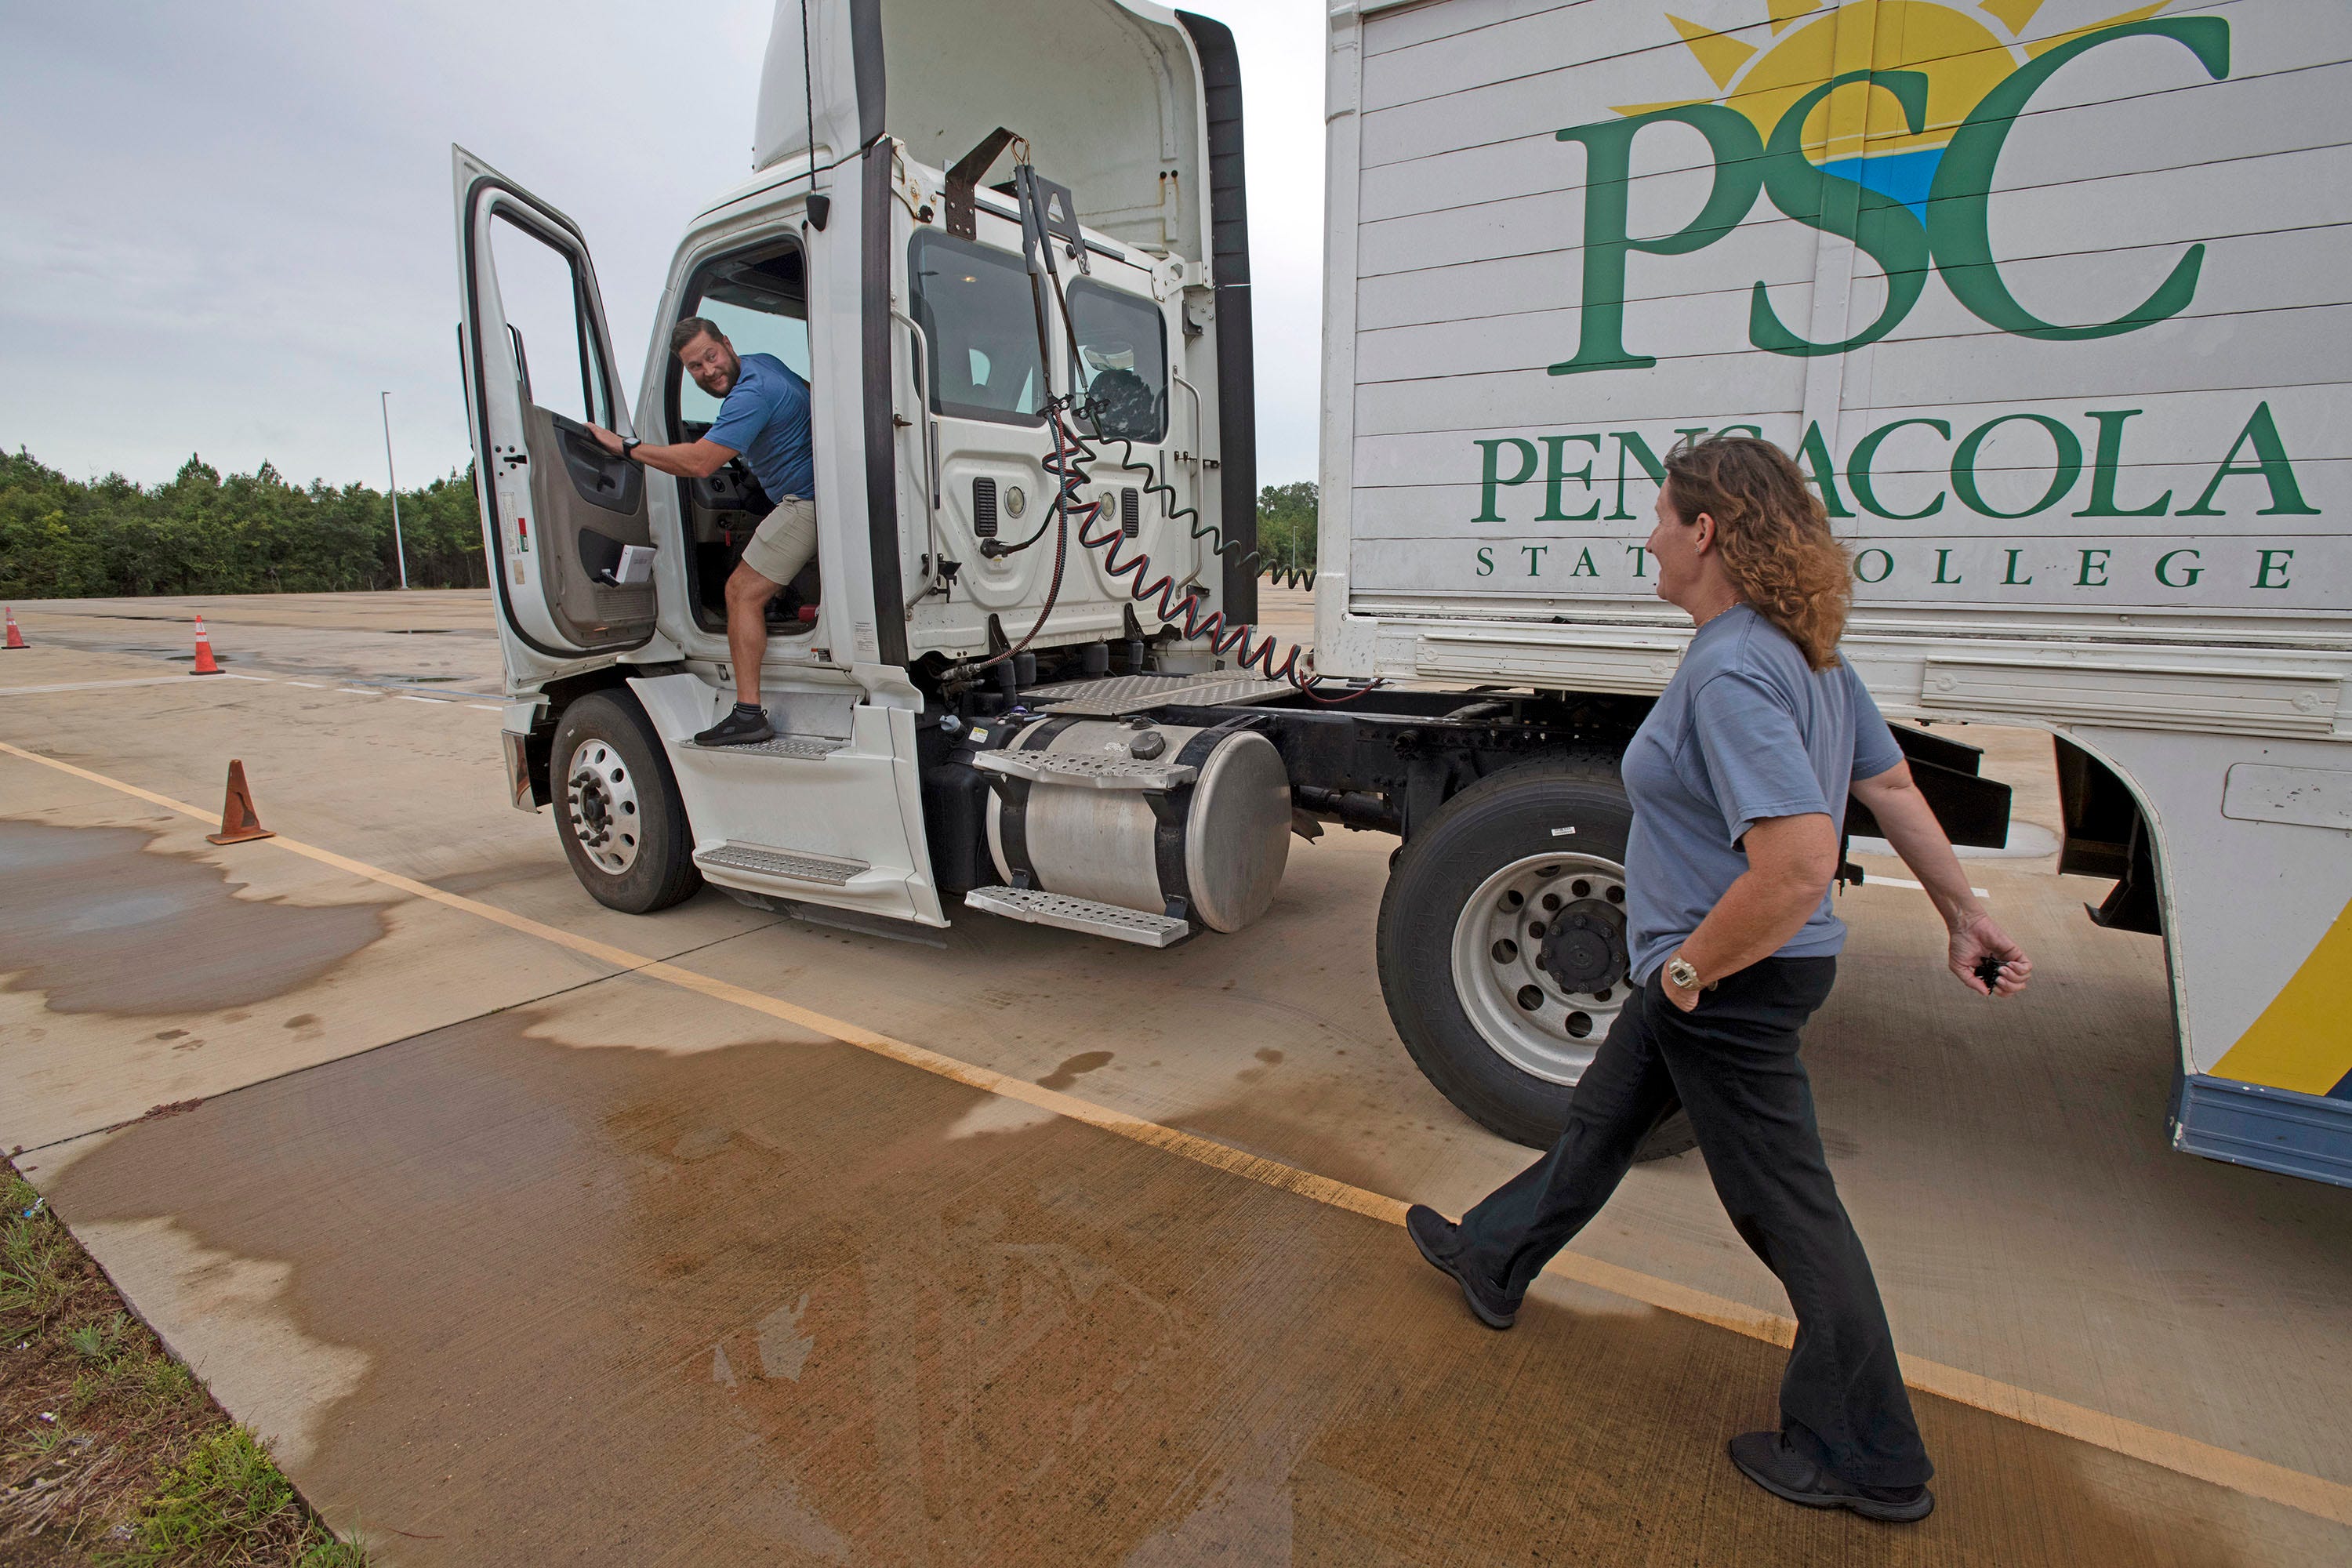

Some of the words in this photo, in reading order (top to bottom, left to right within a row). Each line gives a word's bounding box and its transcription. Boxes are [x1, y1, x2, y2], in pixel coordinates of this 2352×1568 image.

[1547, 16, 2230, 376] PSC
[1470, 401, 2322, 524] PENACOLA
[1475, 545, 1646, 578] STAT
[1852, 548, 2296, 589] OLLEGE
